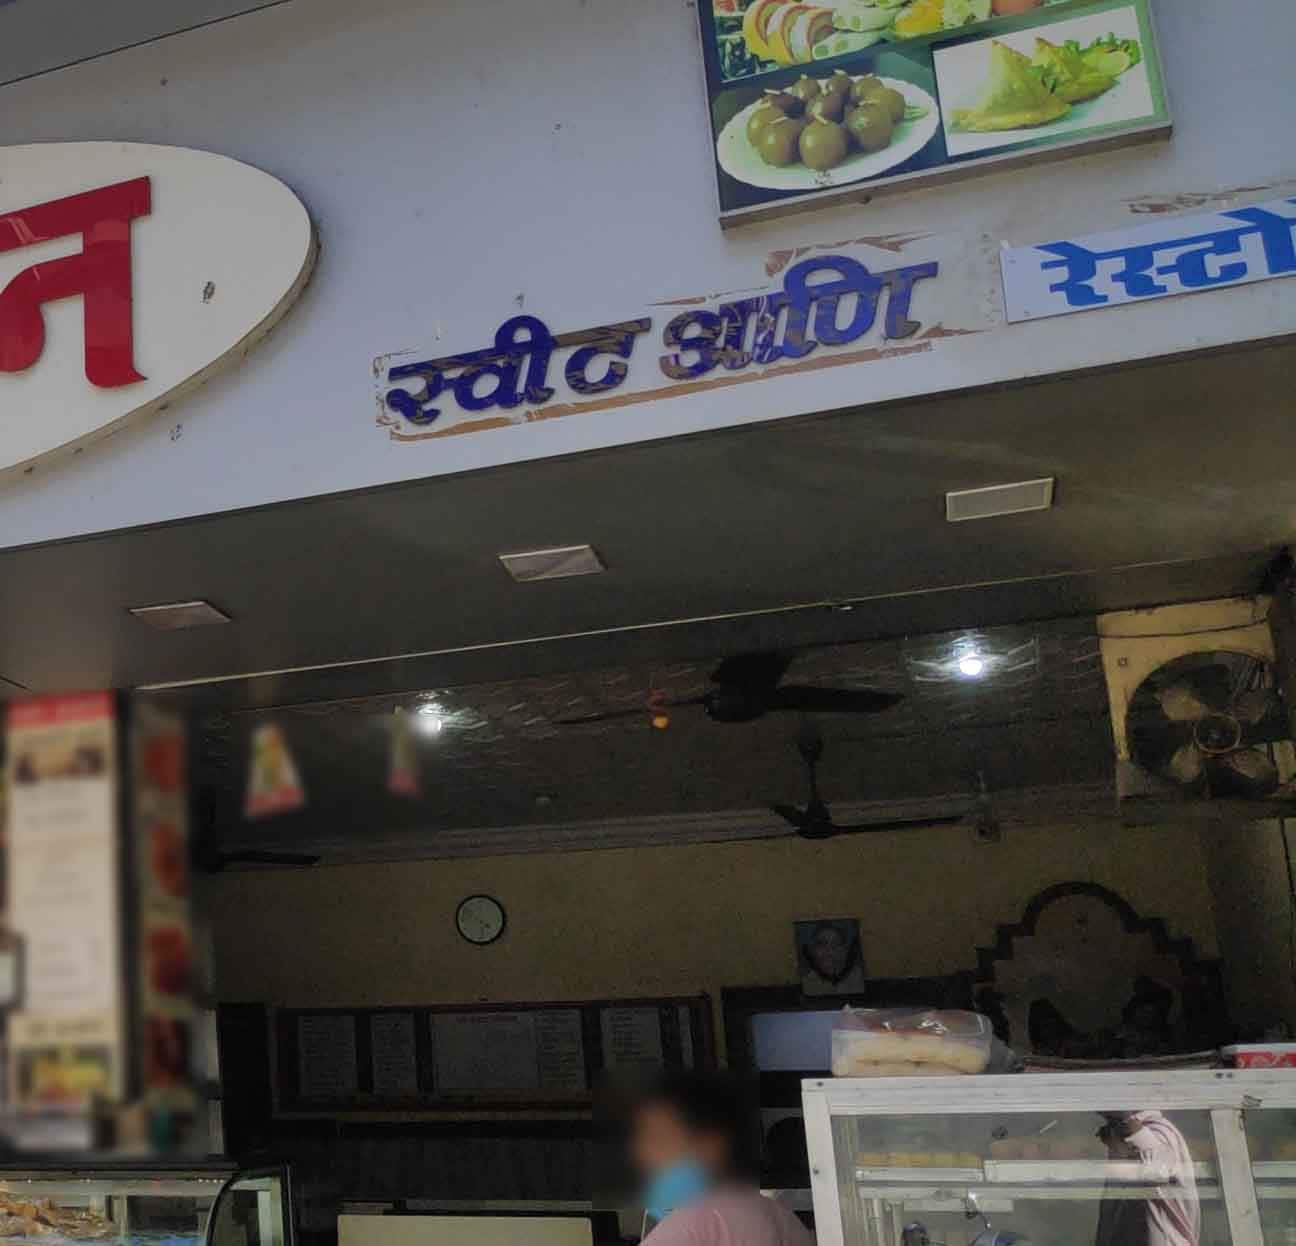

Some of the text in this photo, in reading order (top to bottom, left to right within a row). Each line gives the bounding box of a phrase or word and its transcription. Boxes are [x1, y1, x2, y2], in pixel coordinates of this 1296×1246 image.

[1033, 196, 1296, 306] रेस्टो
[386, 254, 939, 426] स्वीट आणि
